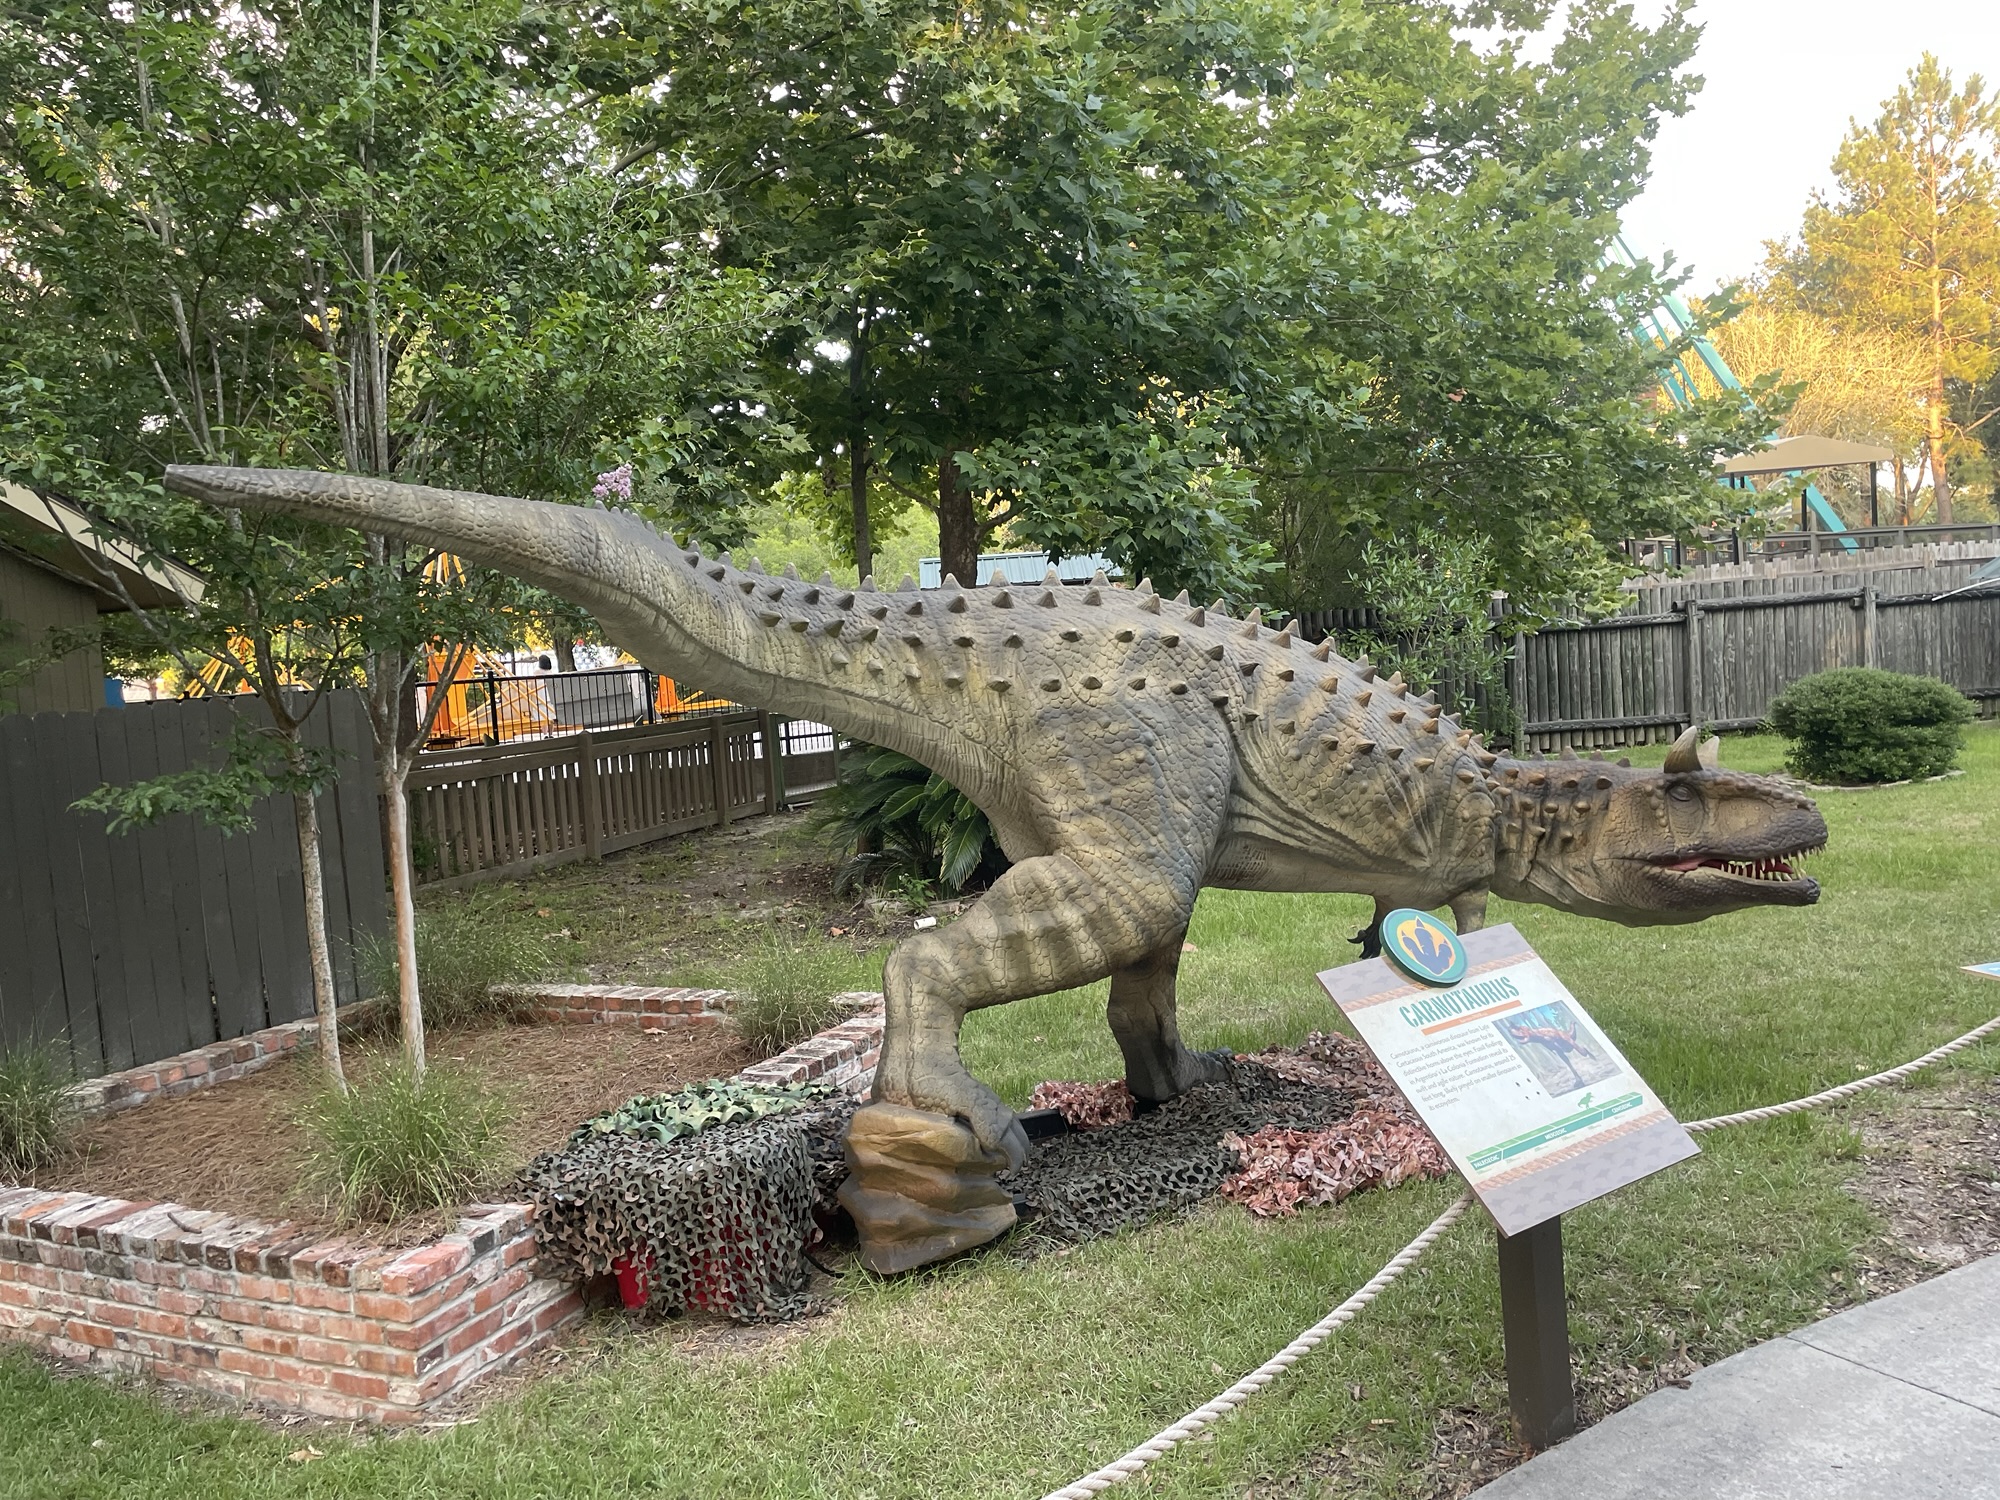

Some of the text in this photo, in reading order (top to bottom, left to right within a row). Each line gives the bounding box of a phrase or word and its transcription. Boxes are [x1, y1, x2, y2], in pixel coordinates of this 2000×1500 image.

[1399, 977, 1519, 1027] CARNOTAURUS
[1450, 1031, 1468, 1040] dinosaur
[1396, 1057, 1423, 1068] Cretaceous
[1422, 1051, 1437, 1059] South
[1437, 1046, 1457, 1054] America,
[1403, 1066, 1427, 1076] distinctive
[1473, 1044, 1486, 1052] Fossil
[1415, 1071, 1441, 1083] Argentina's
[1447, 1063, 1466, 1072] Colonia
[1465, 1055, 1489, 1065] Formation
[1489, 1049, 1502, 1057] reveal
[1416, 1085, 1428, 1093] swift
[1437, 1078, 1448, 1087] agile
[1449, 1074, 1465, 1082] nature.
[1494, 1057, 1510, 1066] around
[1444, 1086, 1458, 1094] likely
[1456, 1079, 1474, 1092] preyed
[1481, 1073, 1497, 1081] smaller
[1497, 1066, 1517, 1076] dinosaurs
